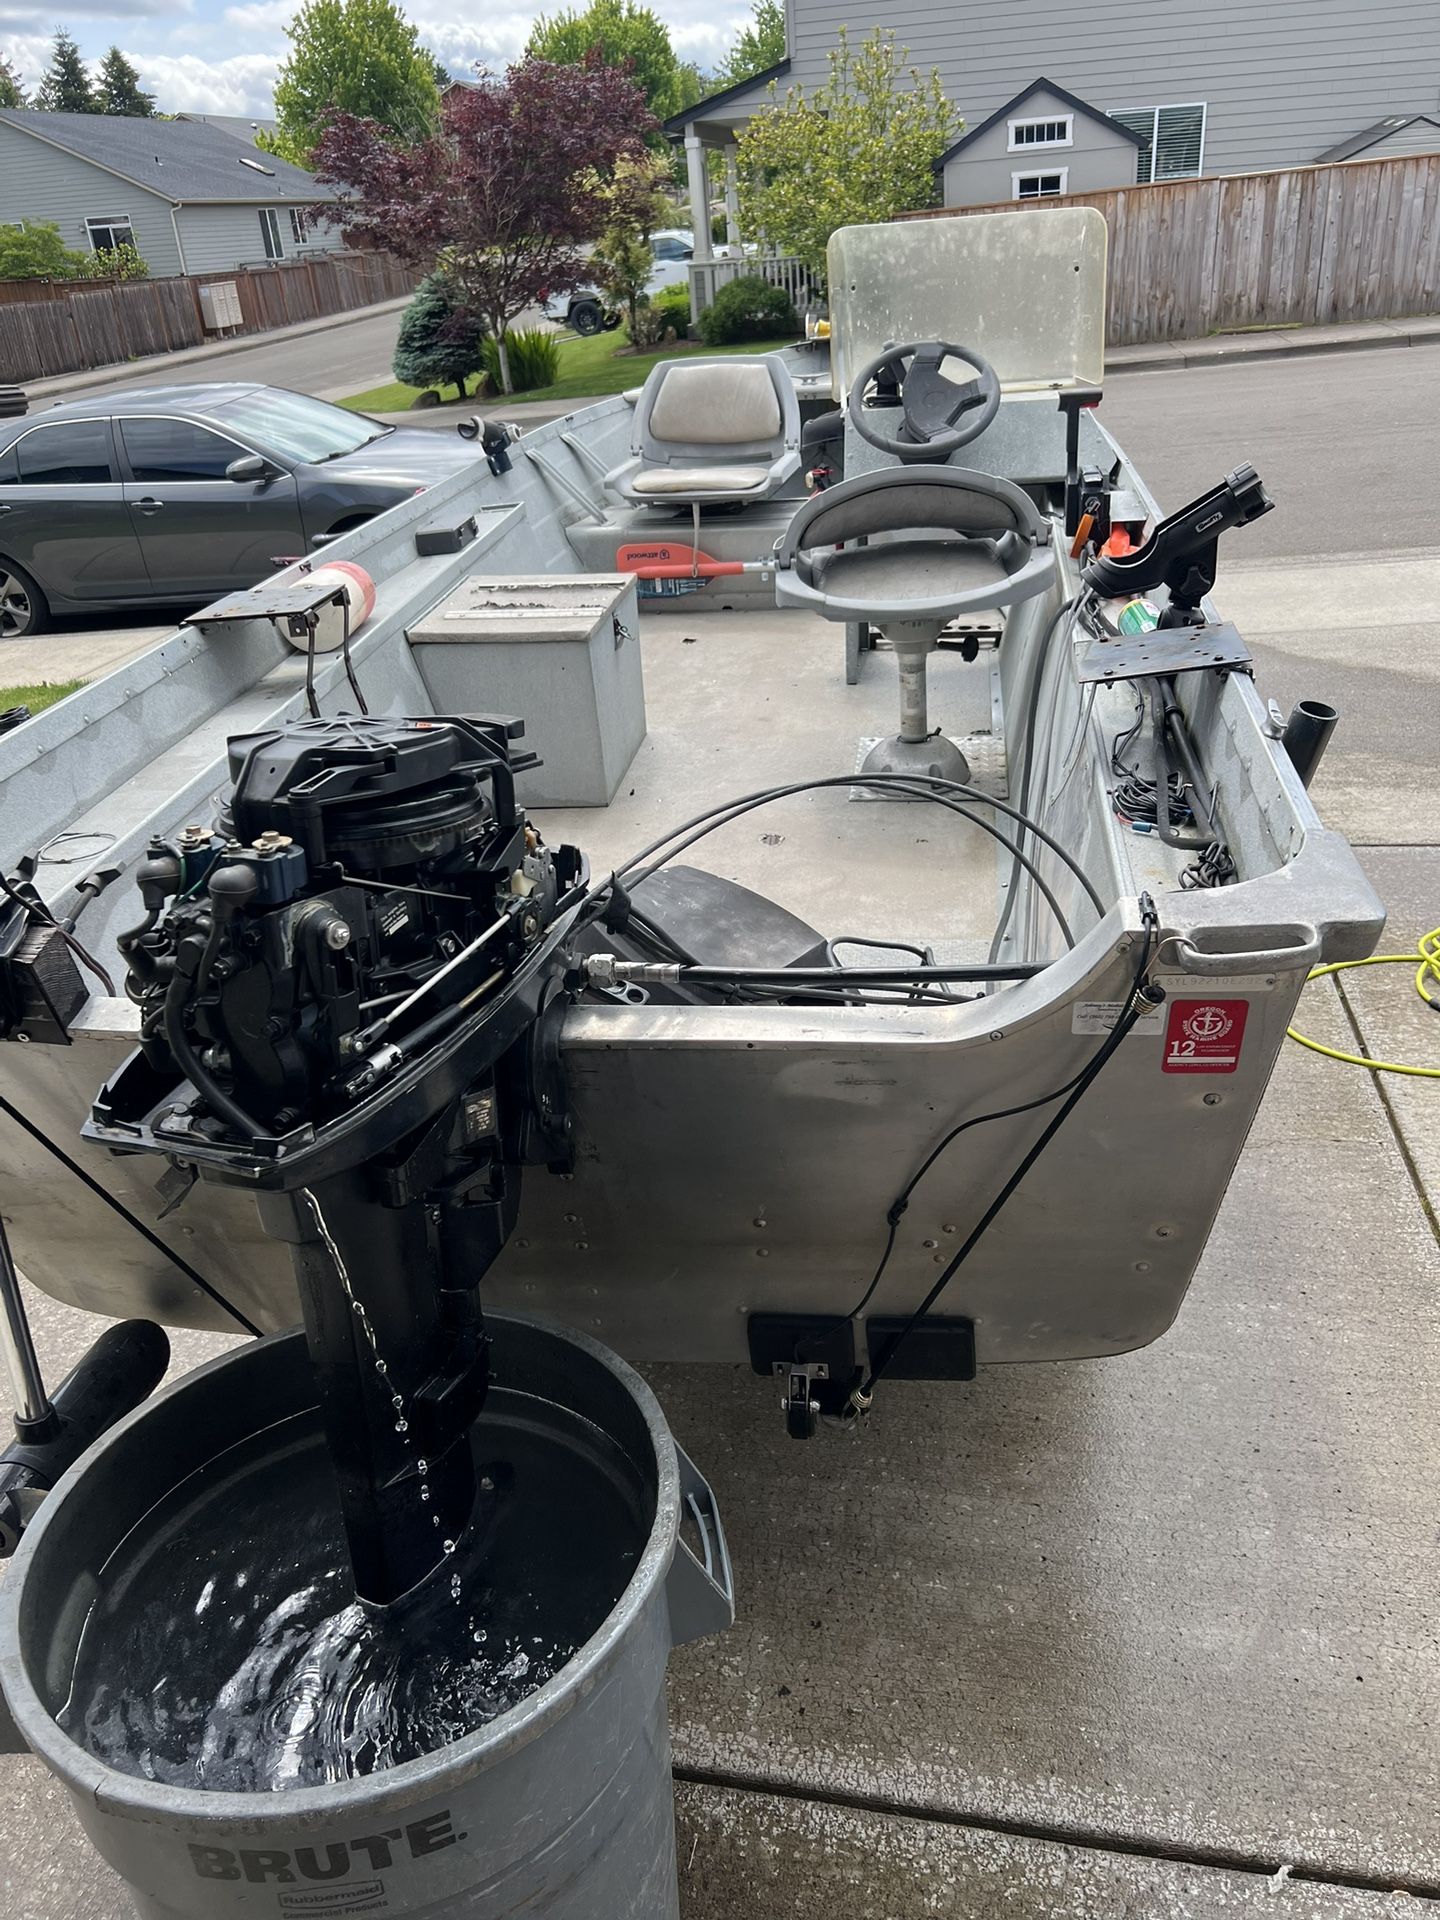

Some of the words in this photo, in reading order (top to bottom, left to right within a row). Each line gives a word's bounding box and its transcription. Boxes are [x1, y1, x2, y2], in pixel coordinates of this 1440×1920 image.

[627, 551, 658, 560] attwood
[1194, 1006, 1227, 1016] OREGON
[1169, 1040, 1196, 1057] 12
[283, 1884, 380, 1904] Rubbermaid
[282, 1909, 343, 1919] Commercial
[345, 1900, 389, 1914] Products
